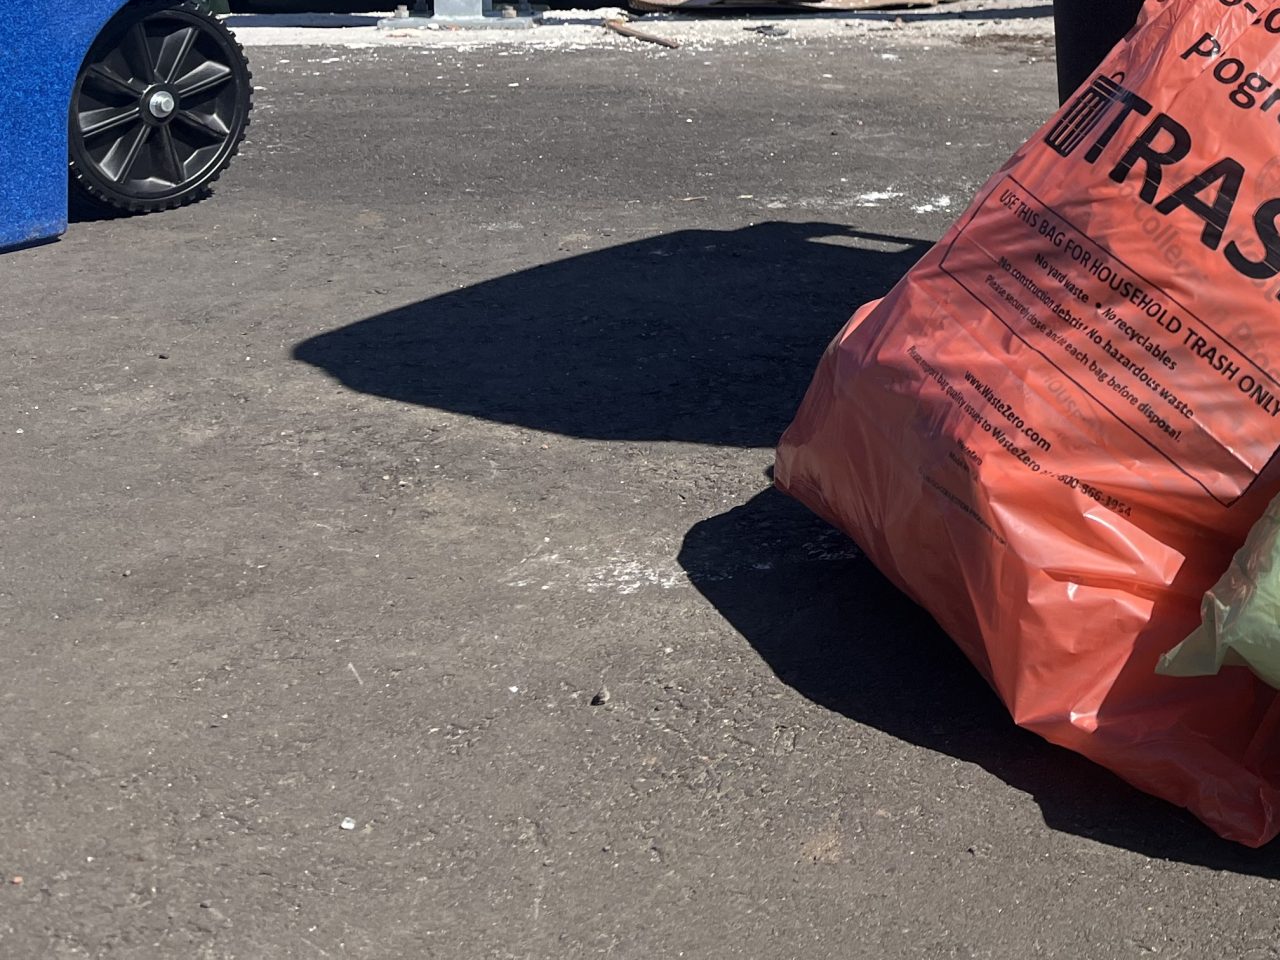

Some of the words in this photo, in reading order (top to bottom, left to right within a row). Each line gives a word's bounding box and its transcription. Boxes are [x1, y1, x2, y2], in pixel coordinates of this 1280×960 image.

[999, 189, 1019, 210] USE
[1014, 202, 1040, 228] THIS
[1038, 219, 1066, 247] BAG
[1063, 238, 1092, 268] FOR
[1088, 258, 1182, 334] HOUSEHOLD
[1183, 327, 1240, 381] TRASH
[1034, 253, 1049, 270] No
[1046, 265, 1068, 284] yard
[1063, 279, 1089, 303] waste
[1102, 307, 1117, 321] No
[1114, 318, 1178, 371] recyclables
[999, 255, 1012, 272] No
[1086, 328, 1103, 345] No
[1102, 339, 1161, 391] hazardous
[1159, 387, 1194, 419] waste
[1064, 342, 1089, 366] each
[1088, 360, 1109, 383] bag
[1106, 375, 1139, 405] before
[964, 370, 1052, 452] www.WasteZero.com
[981, 419, 992, 432] to
[991, 426, 1041, 473] WasteZero
